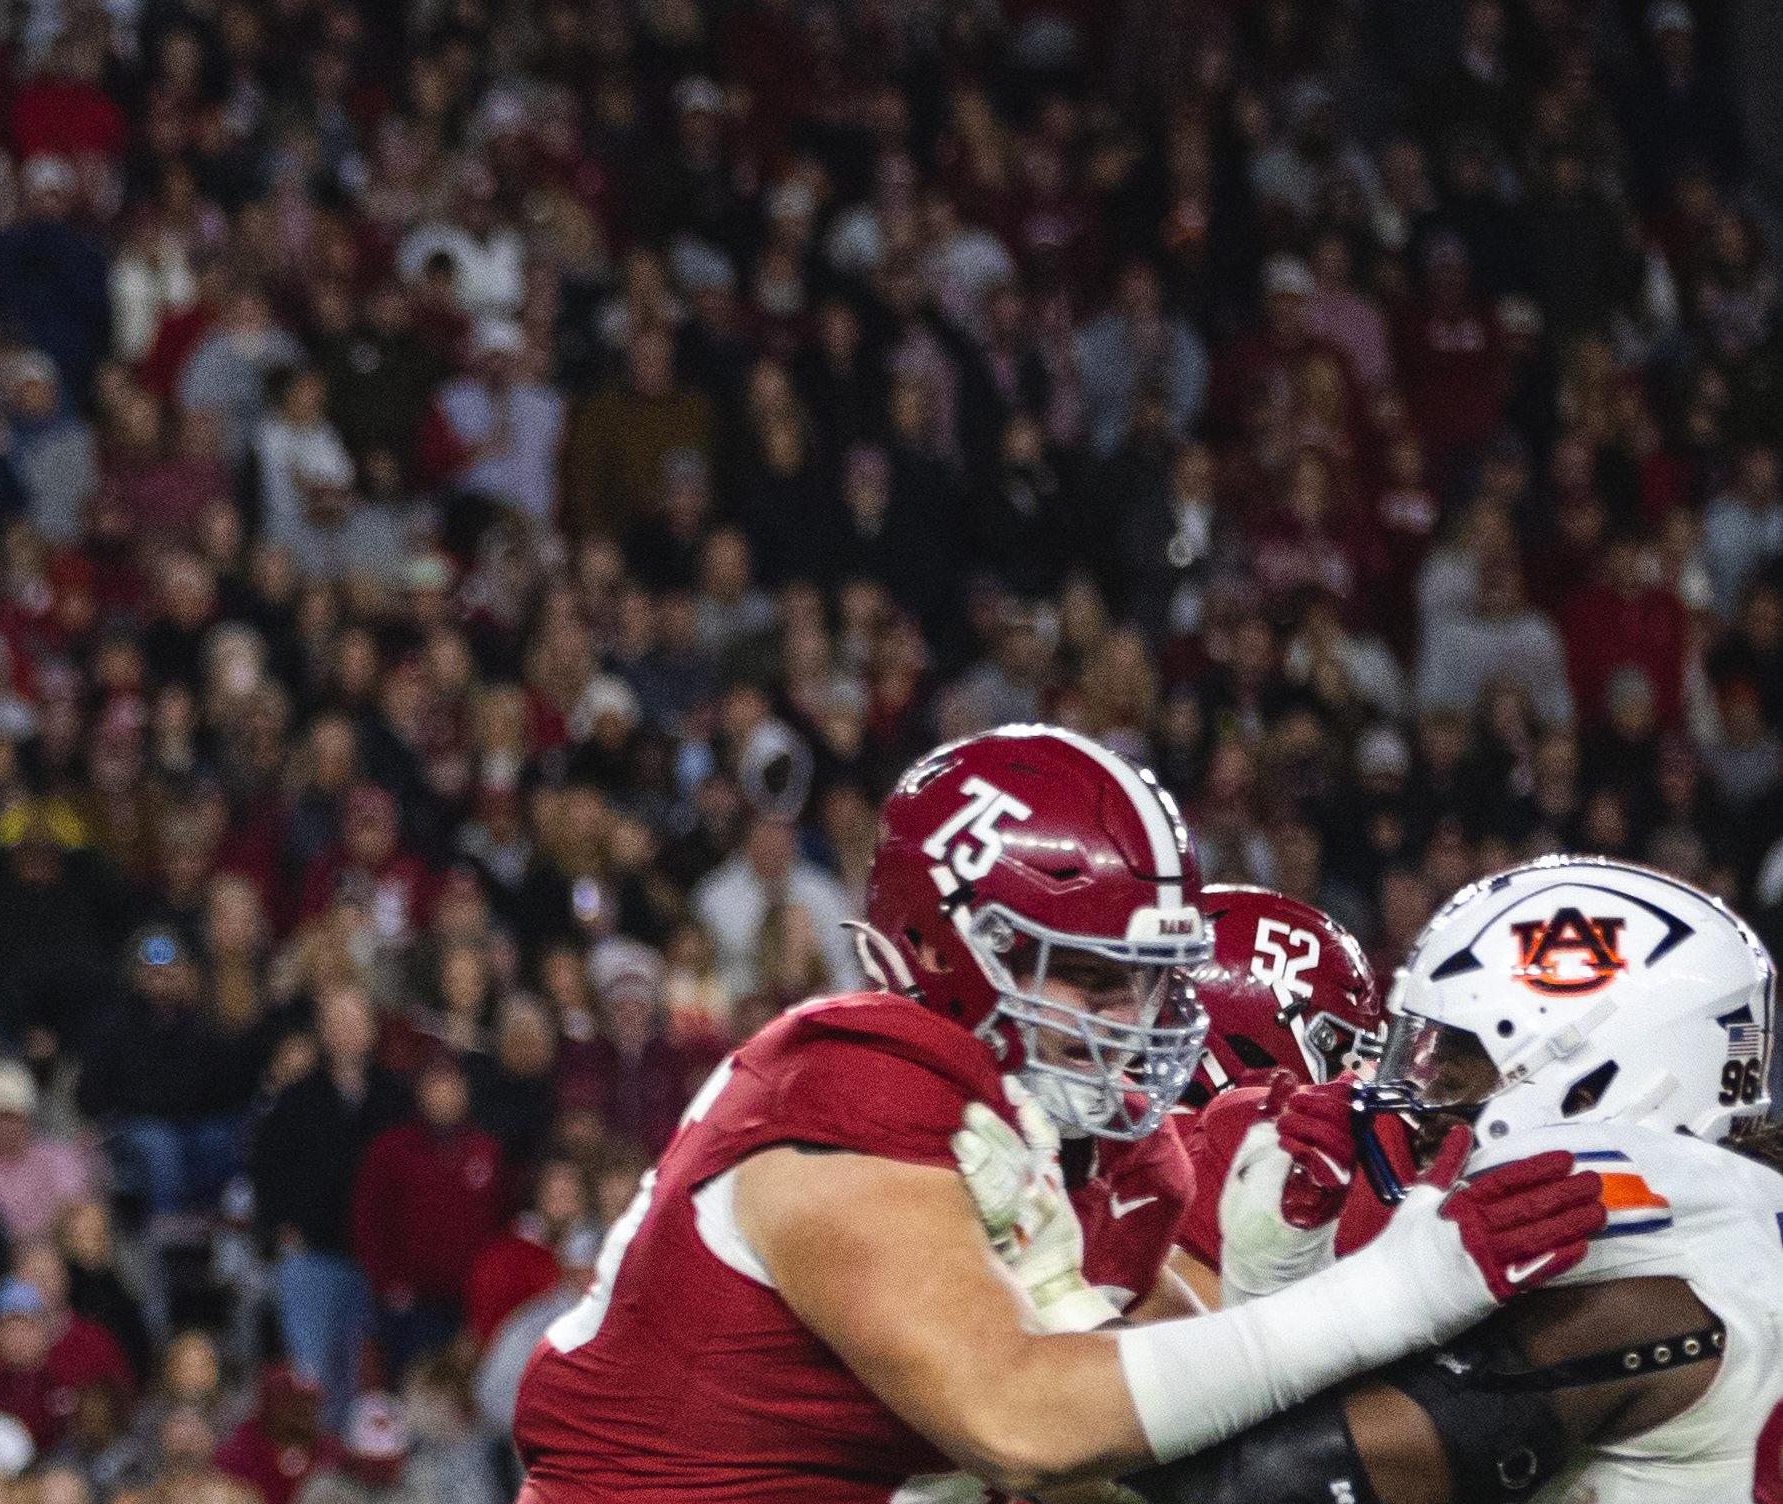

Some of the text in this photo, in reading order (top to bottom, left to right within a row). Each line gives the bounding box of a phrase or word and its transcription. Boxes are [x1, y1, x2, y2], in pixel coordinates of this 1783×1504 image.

[923, 777, 1033, 880] 75
[1251, 917, 1320, 998] 52
[1718, 1058, 1762, 1107] 96
